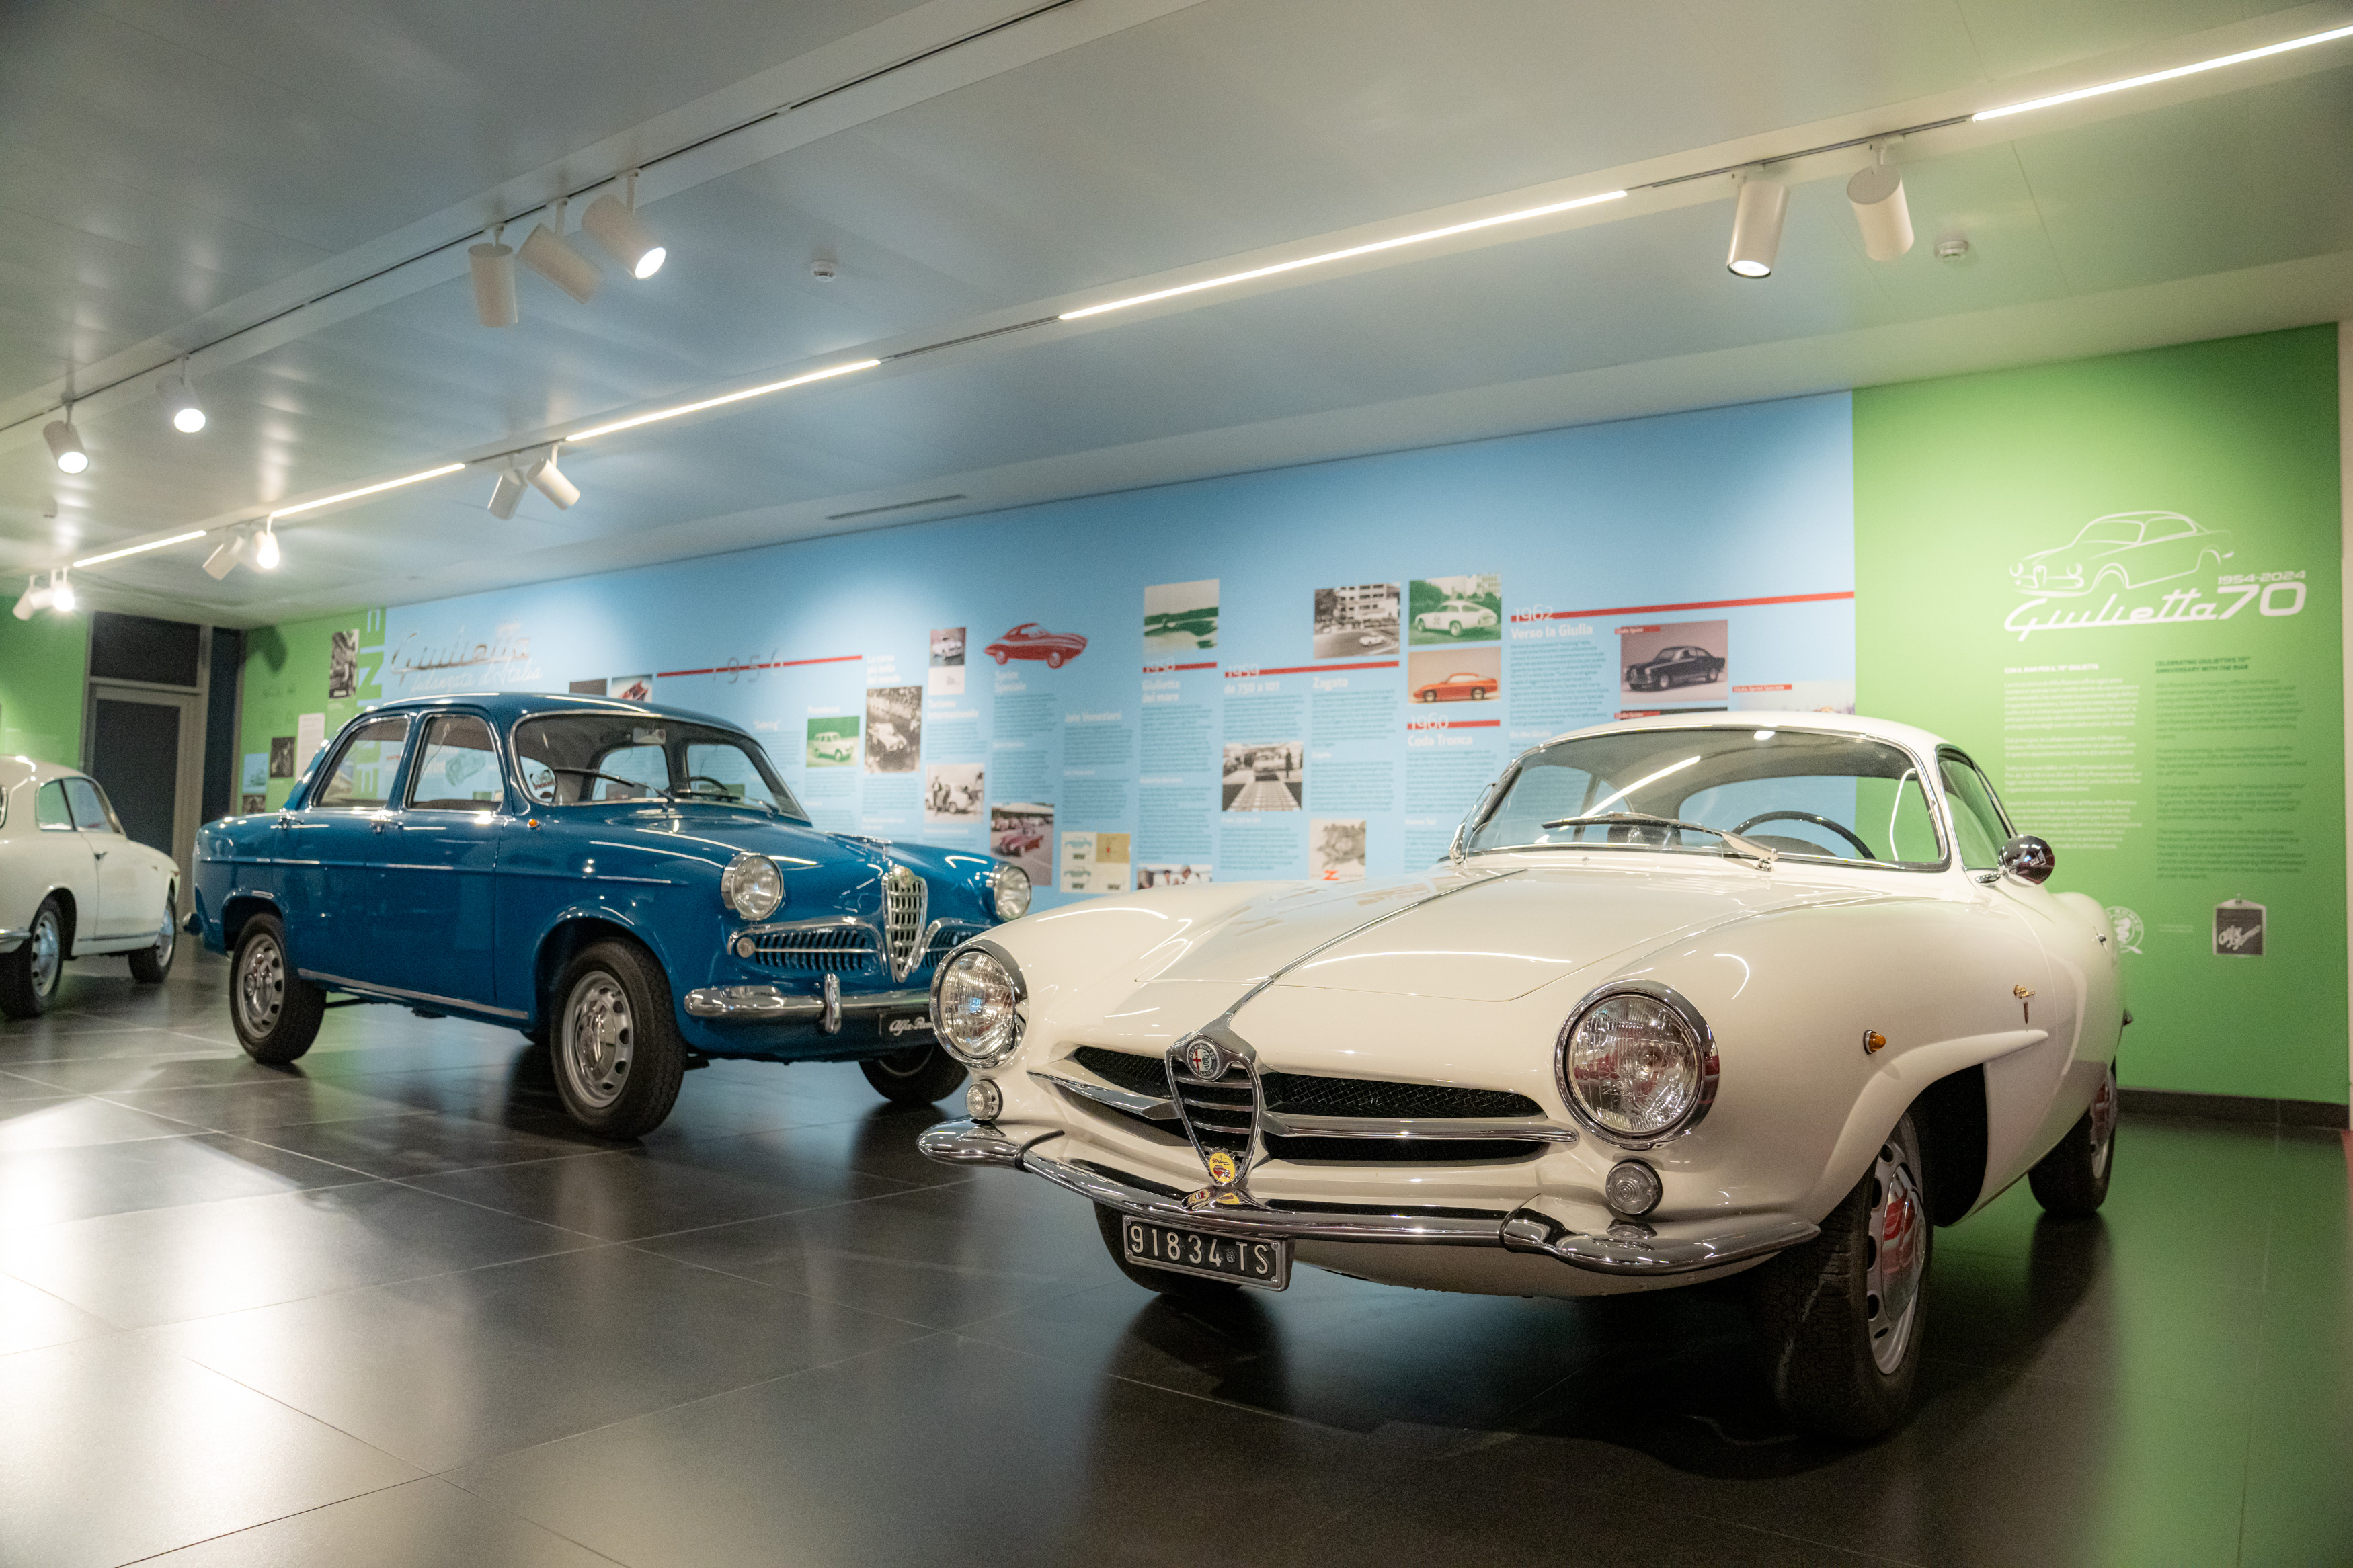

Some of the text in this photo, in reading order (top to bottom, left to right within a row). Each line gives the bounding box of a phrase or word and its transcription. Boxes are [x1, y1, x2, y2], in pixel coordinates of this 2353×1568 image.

[2218, 569, 2306, 585] 1954-2024
[1515, 604, 1553, 625] 1962
[2004, 582, 2307, 642] Giulietta 70
[1511, 623, 1593, 639] Verso la Giulia
[391, 621, 531, 686] Giulietta
[1224, 683, 1236, 694] da
[1238, 682, 1255, 695] 750
[1312, 677, 1349, 691] Zagato
[1412, 712, 1449, 733] 1960
[1408, 733, 1473, 747] Coda Tronca
[889, 1019, 913, 1036] Alfa
[1131, 1225, 1269, 1275] 91834 TS
